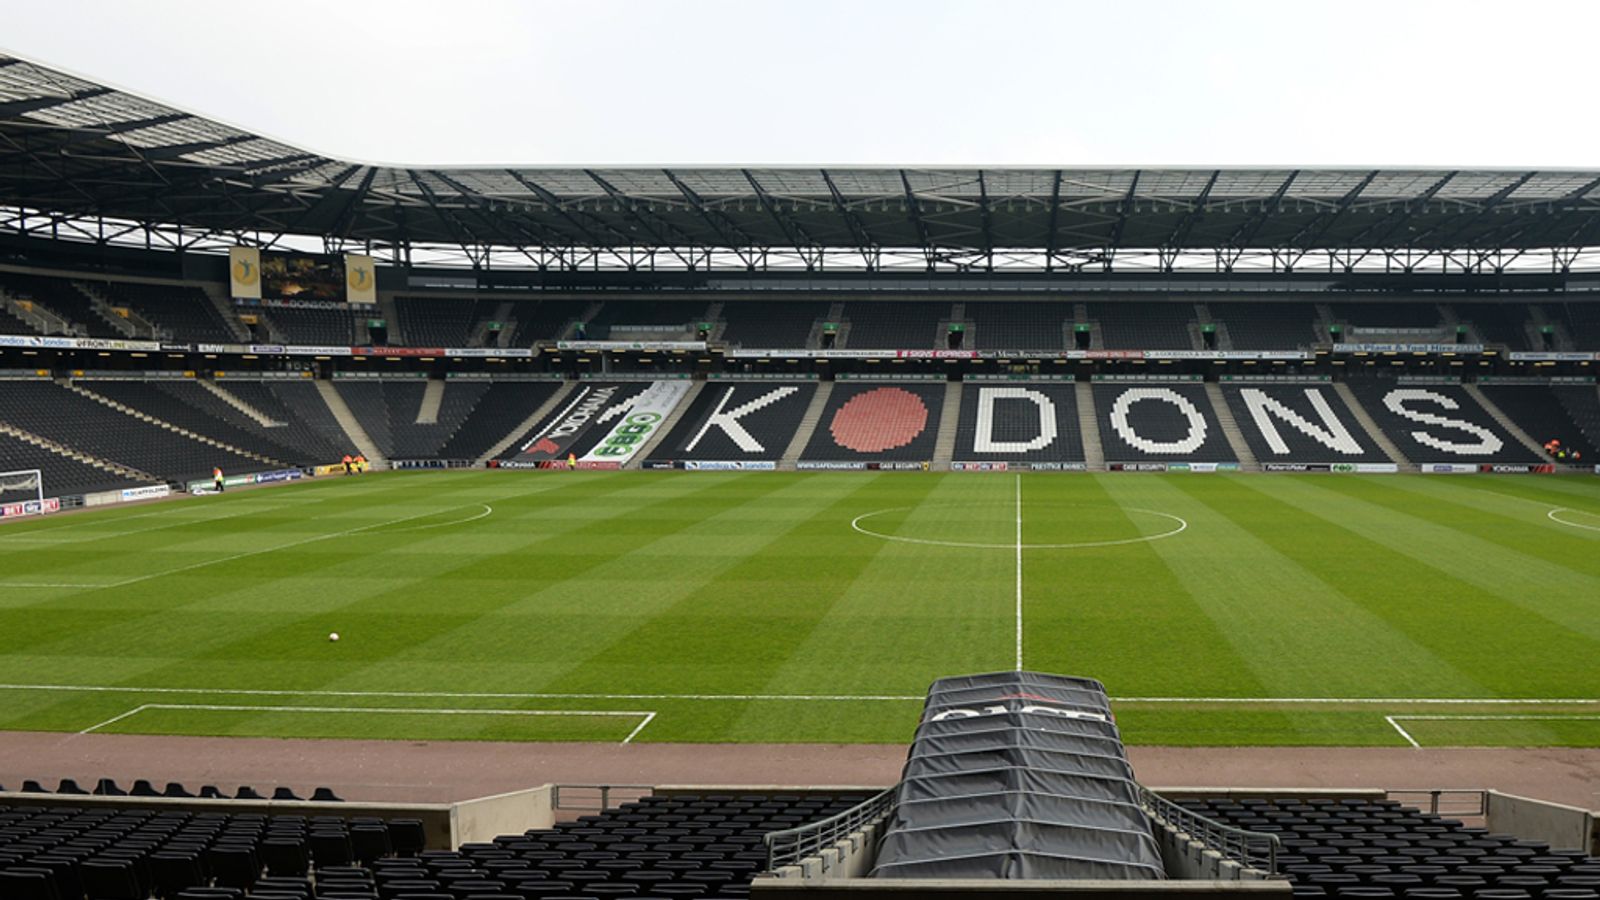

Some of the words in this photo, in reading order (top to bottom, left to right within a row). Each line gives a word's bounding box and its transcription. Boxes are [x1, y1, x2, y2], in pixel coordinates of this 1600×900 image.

[547, 385, 619, 438] YOKOHAMA
[973, 387, 1503, 454] DONS
[1493, 465, 1530, 473] YOKOHAMA
